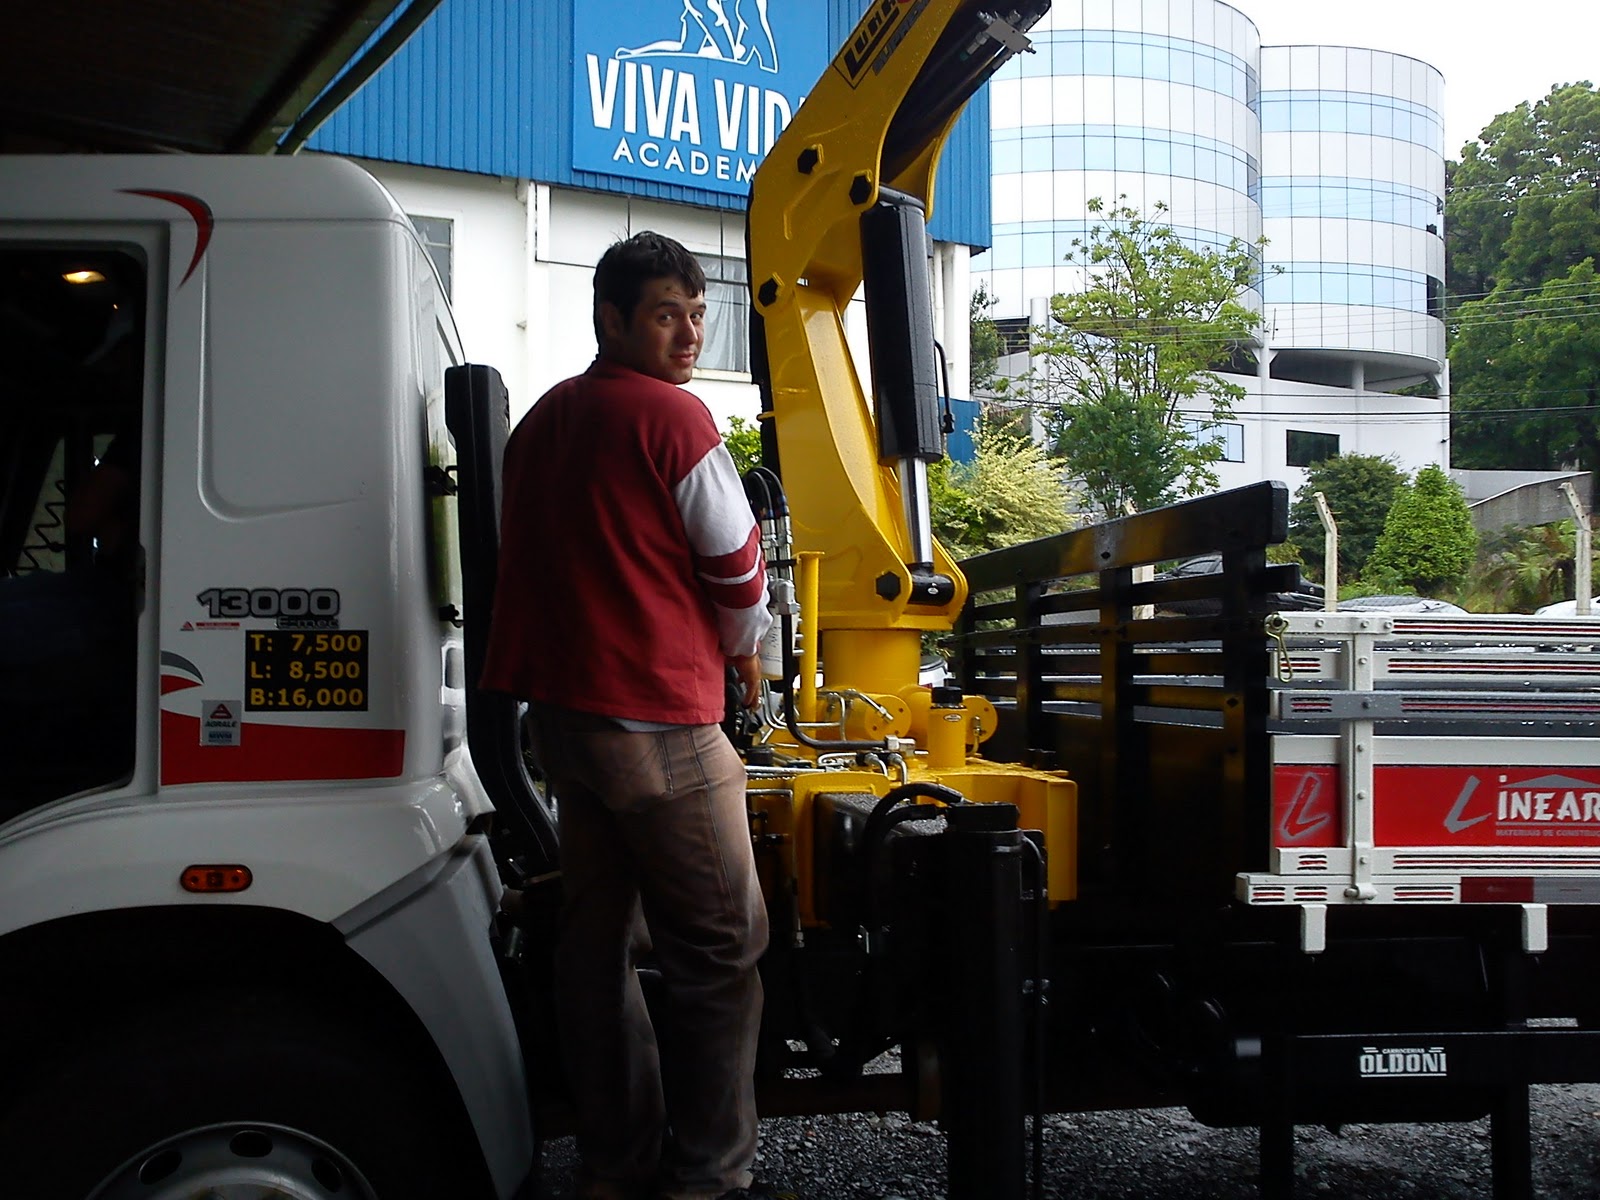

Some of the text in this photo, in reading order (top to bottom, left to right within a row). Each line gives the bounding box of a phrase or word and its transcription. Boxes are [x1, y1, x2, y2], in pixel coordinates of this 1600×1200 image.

[586, 53, 806, 157] VIVA VID
[197, 588, 340, 618] 13000
[250, 634, 361, 655] T: 7,500
[251, 661, 360, 682] L: 8,500
[1360, 1053, 1447, 1073] OLDONI
